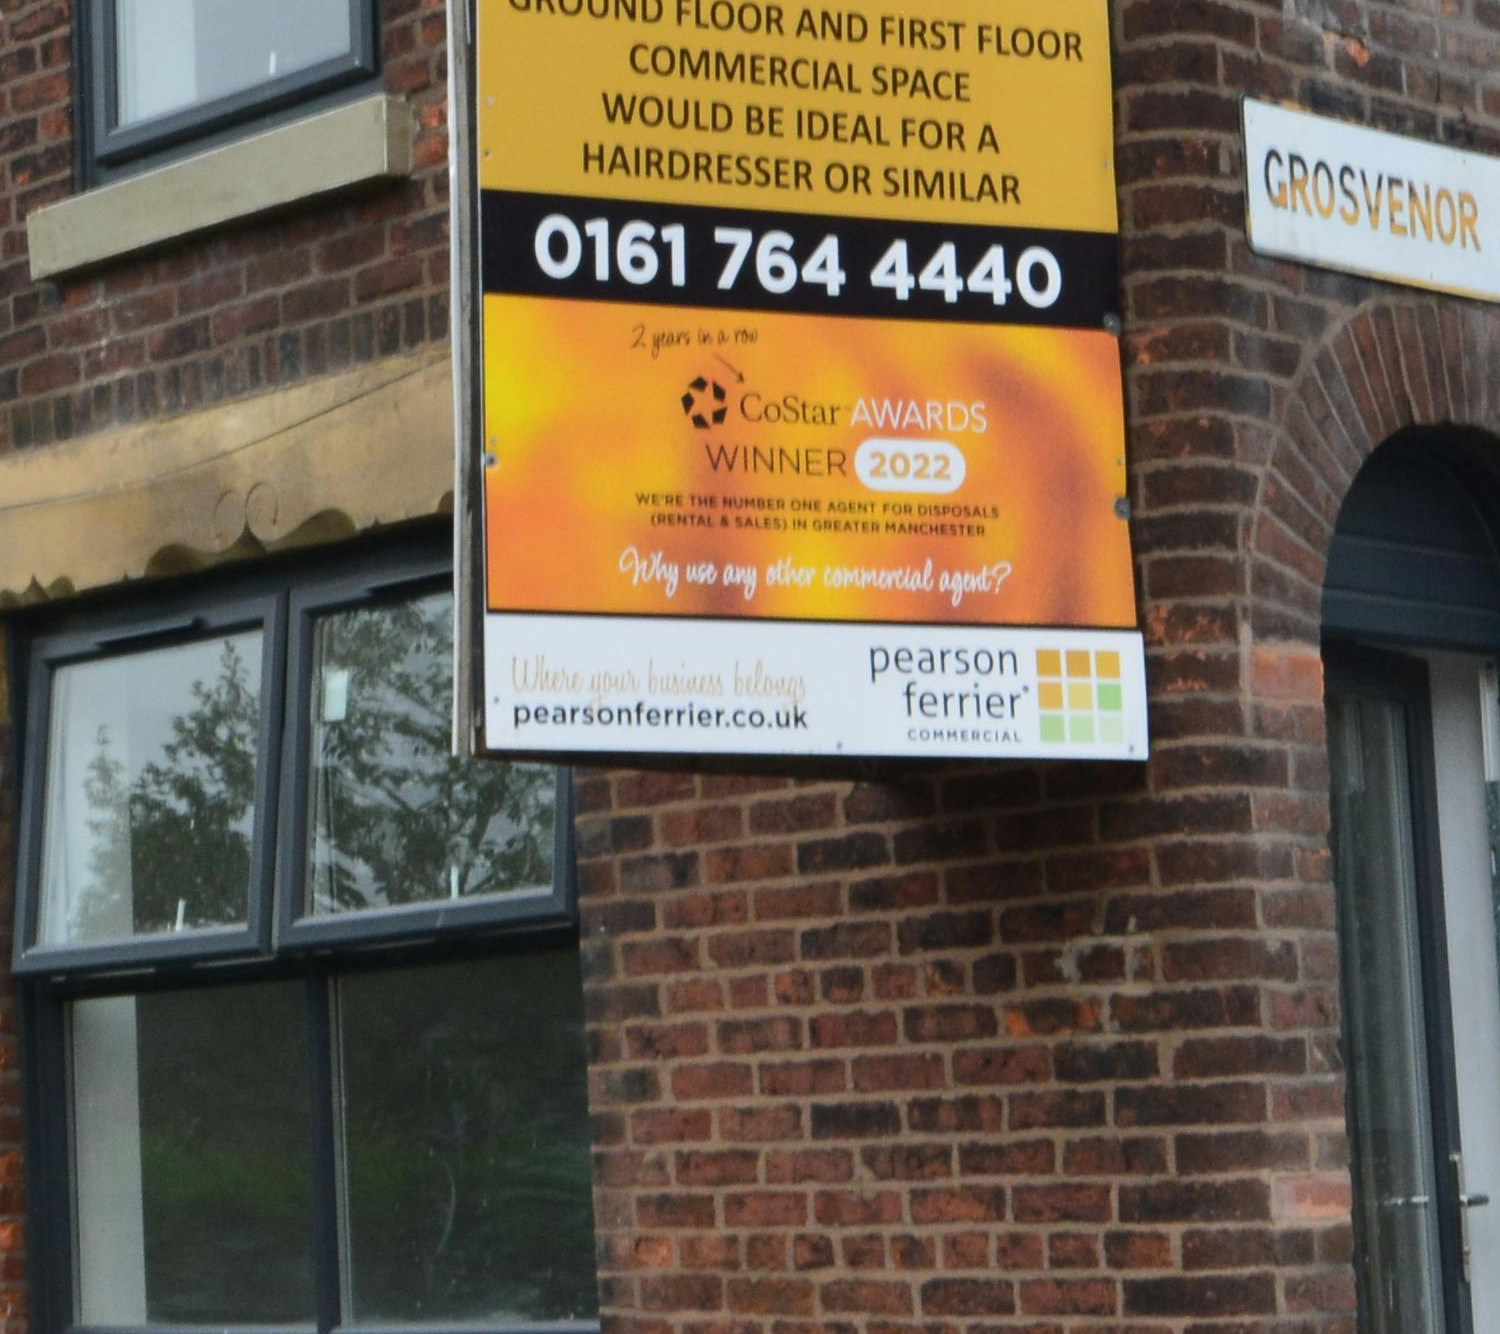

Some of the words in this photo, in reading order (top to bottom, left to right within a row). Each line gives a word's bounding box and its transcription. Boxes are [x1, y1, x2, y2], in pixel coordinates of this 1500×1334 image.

[796, 8, 868, 44] AND
[881, 15, 966, 52] FIRST
[978, 24, 1083, 62] FLOOR
[629, 43, 861, 94] COMMERCIAL
[872, 64, 971, 103] SPACE
[602, 92, 733, 133] WOULD
[745, 104, 784, 138] BE
[796, 109, 890, 147] IDEAL
[901, 118, 966, 152] FOR
[977, 123, 1000, 155] A
[583, 142, 814, 192] HAIRDRESSER
[824, 161, 872, 196] OR
[883, 166, 1021, 205] SIMILAR
[1263, 148, 1481, 252] GROSVENOR
[534, 213, 686, 287] 0161
[714, 227, 847, 296] 764
[870, 238, 1062, 309] 4440
[631, 322, 646, 349] 2
[651, 329, 690, 359] years
[697, 328, 713, 345] in
[717, 328, 729, 344] a
[734, 327, 759, 344] row
[739, 393, 839, 426] CoStar
[850, 396, 988, 434] AWARDS
[705, 443, 848, 478] WINNER
[868, 451, 952, 481] 2022
[635, 493, 684, 507] WE'RE
[689, 495, 718, 509] THE
[723, 496, 785, 511] NUMBER
[790, 499, 821, 512] ONE
[828, 501, 875, 514] AGENT
[883, 503, 913, 516] FOR
[917, 504, 1000, 520] DISPOSALS
[650, 513, 715, 529] (RENTAL
[720, 515, 729, 528] &
[735, 516, 788, 532] SALES)
[792, 519, 807, 531] IN
[812, 519, 880, 534] GREATER
[885, 521, 985, 537] MANCHESTER
[618, 546, 679, 599] Why
[686, 561, 716, 585] use
[722, 561, 758, 601] any
[766, 554, 815, 590] other
[823, 556, 934, 594] commercial
[939, 559, 1012, 607] agent?
[511, 653, 583, 694] Where
[589, 673, 640, 709] your
[648, 658, 724, 697] business
[733, 658, 806, 707] belongs
[869, 645, 1018, 683] pearson
[512, 700, 808, 730] pearsonferrier.co.uk
[903, 680, 1021, 718] ferrier
[907, 728, 1022, 743] COMMERCIAL
